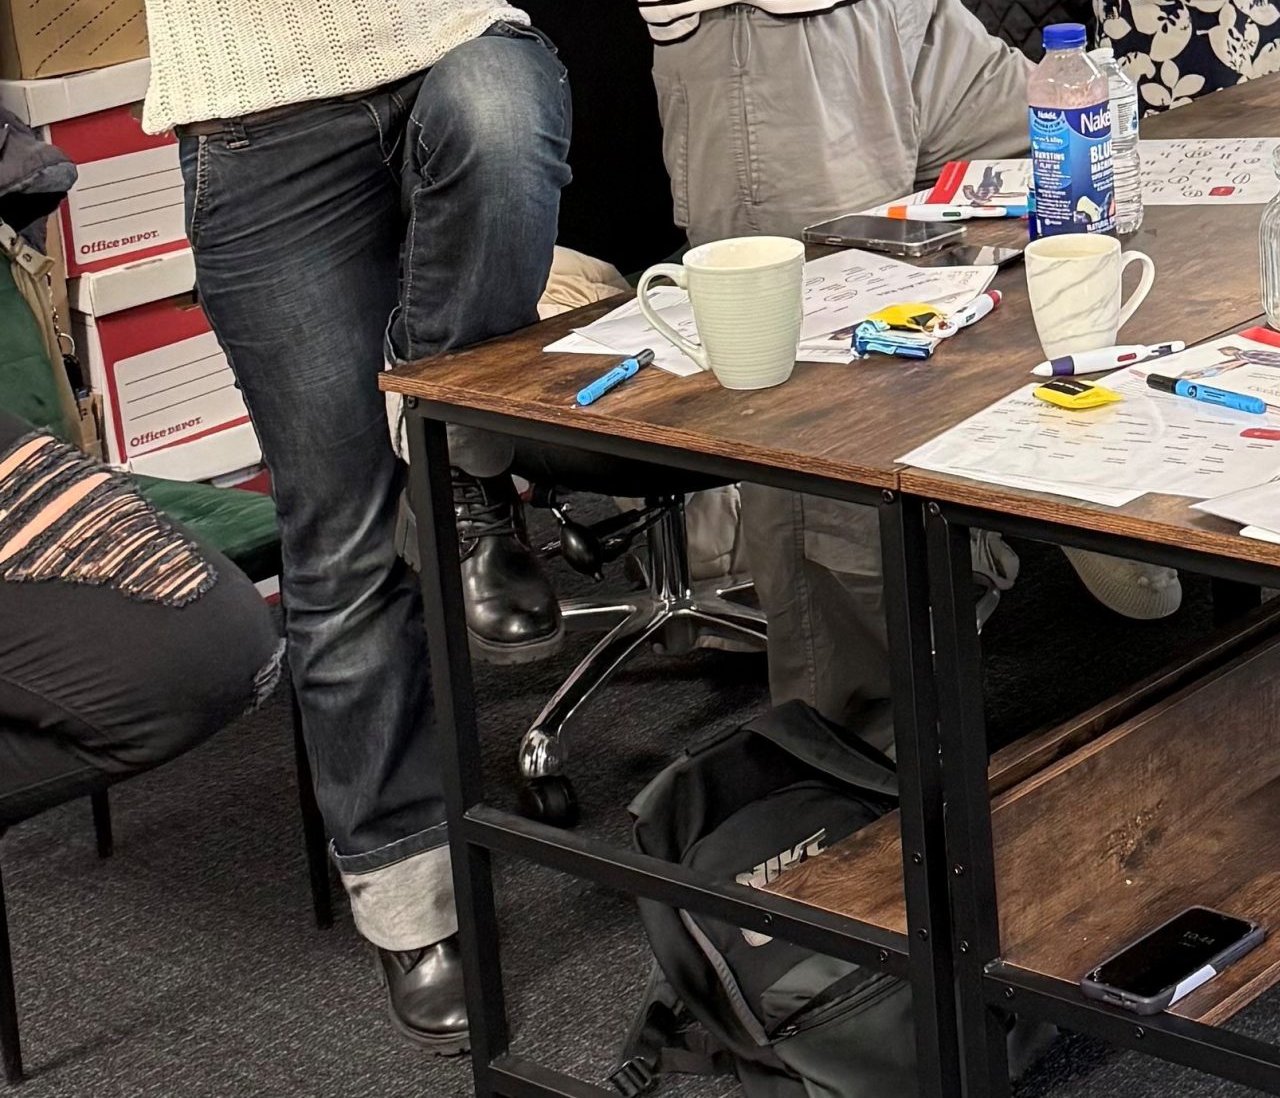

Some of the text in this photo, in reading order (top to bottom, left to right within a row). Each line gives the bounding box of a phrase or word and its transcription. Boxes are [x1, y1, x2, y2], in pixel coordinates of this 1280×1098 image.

[1080, 107, 1111, 134] Nake
[81, 239, 120, 255] Office
[130, 430, 166, 447] Office
